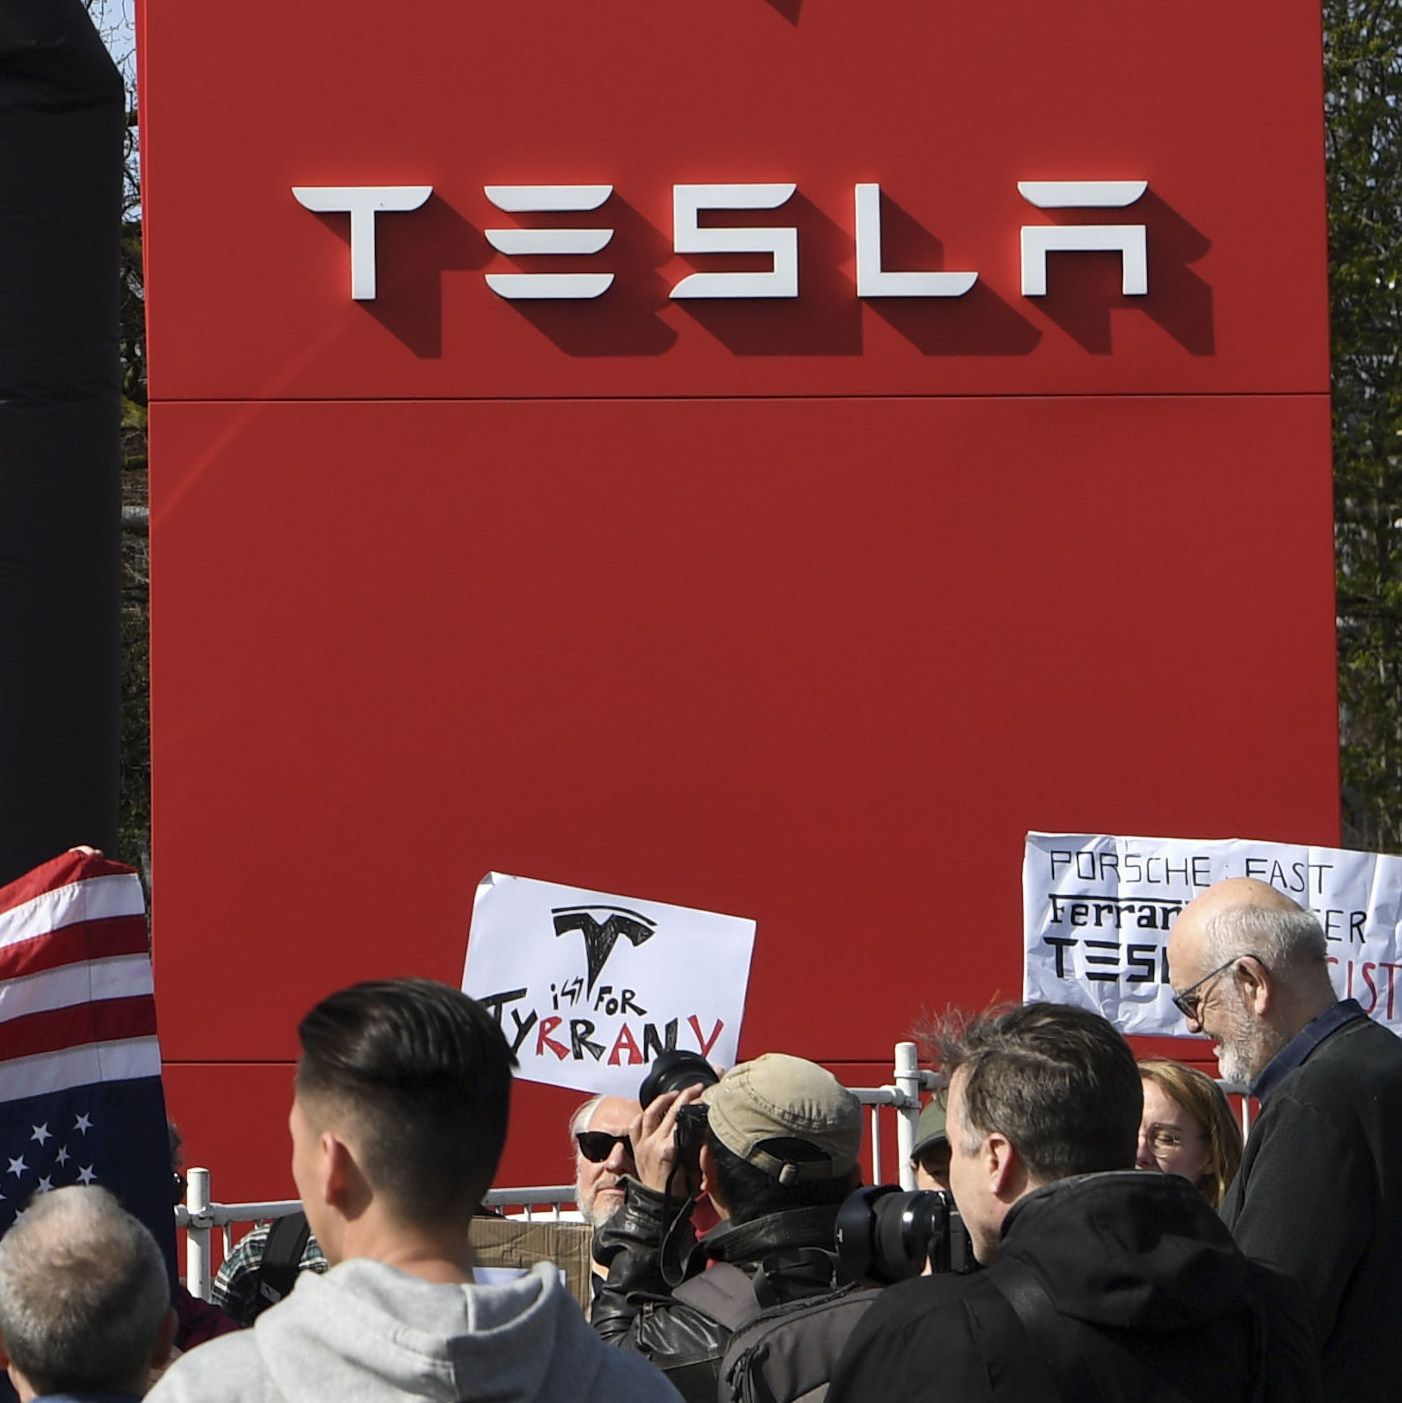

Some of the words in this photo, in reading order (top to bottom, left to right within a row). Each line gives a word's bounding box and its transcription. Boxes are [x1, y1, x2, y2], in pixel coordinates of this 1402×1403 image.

[291, 180, 1150, 301] TESLA
[1050, 849, 1211, 887] PORSCHE
[1245, 857, 1334, 895] FAST
[1048, 893, 1190, 930] Ferrar
[594, 986, 648, 1017] FOR
